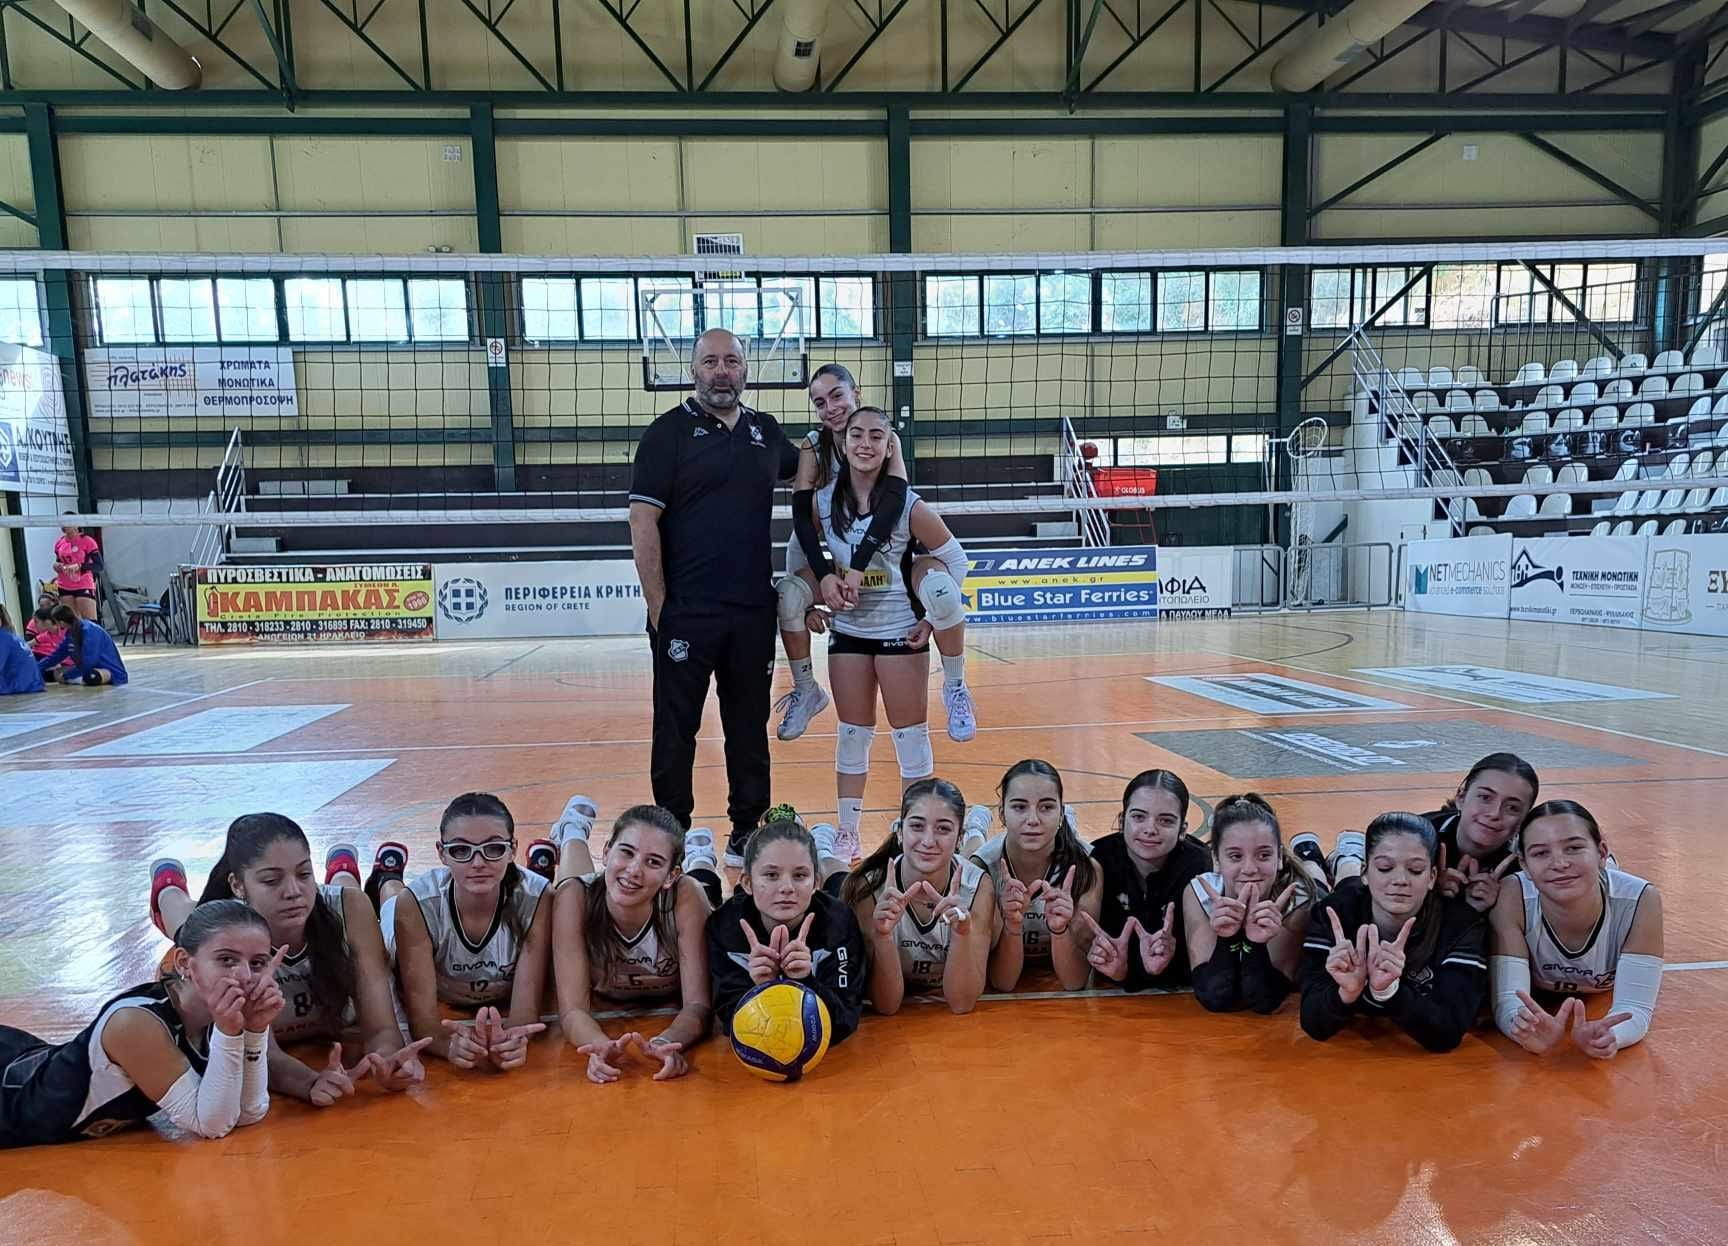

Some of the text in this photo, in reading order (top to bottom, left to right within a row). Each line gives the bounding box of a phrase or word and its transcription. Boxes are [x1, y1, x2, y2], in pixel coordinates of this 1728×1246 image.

[220, 360, 271, 370] ΧΡΩΜΑΤΑ
[218, 378, 275, 388] ΜΟΝΩΤΙΚΑ
[203, 395, 294, 406] ΘΕΡΜΟΠΡΟΣΟΨΗ
[998, 554, 1149, 571] ANEK LINES
[207, 566, 315, 583] ΠΥΡΟΣΒΕΣΤΙΚΑ
[326, 565, 424, 582] ΑΝΑΓΟΜΩΣΕΙΣ
[1429, 560, 1506, 582] NETMECHANICS
[1571, 570, 1639, 582] ΤΕΧΝΙΚΗ ΜΟΝΩΤΙΚΗ
[998, 575, 1104, 586] www.anek.gr
[505, 584, 641, 600] ΠΕΡΙΦΕΡΕΙΑ ΚΡΗΤΗ
[981, 588, 1150, 607] Blue Star Ferries
[219, 589, 401, 613] ΚΑΜΠΑΚΑΣ
[505, 602, 590, 612] REGION OF CRETE
[204, 622, 225, 633] ΤΗΛ.
[227, 622, 248, 633] 2810
[254, 621, 285, 632] 318233
[290, 621, 311, 631] 2810
[349, 619, 369, 630] FAX:
[370, 619, 391, 629] 2810
[397, 618, 427, 629] 319450
[452, 960, 498, 973] GIVOVA
[912, 960, 933, 975] 18
[1542, 963, 1593, 977] GIVOVA
